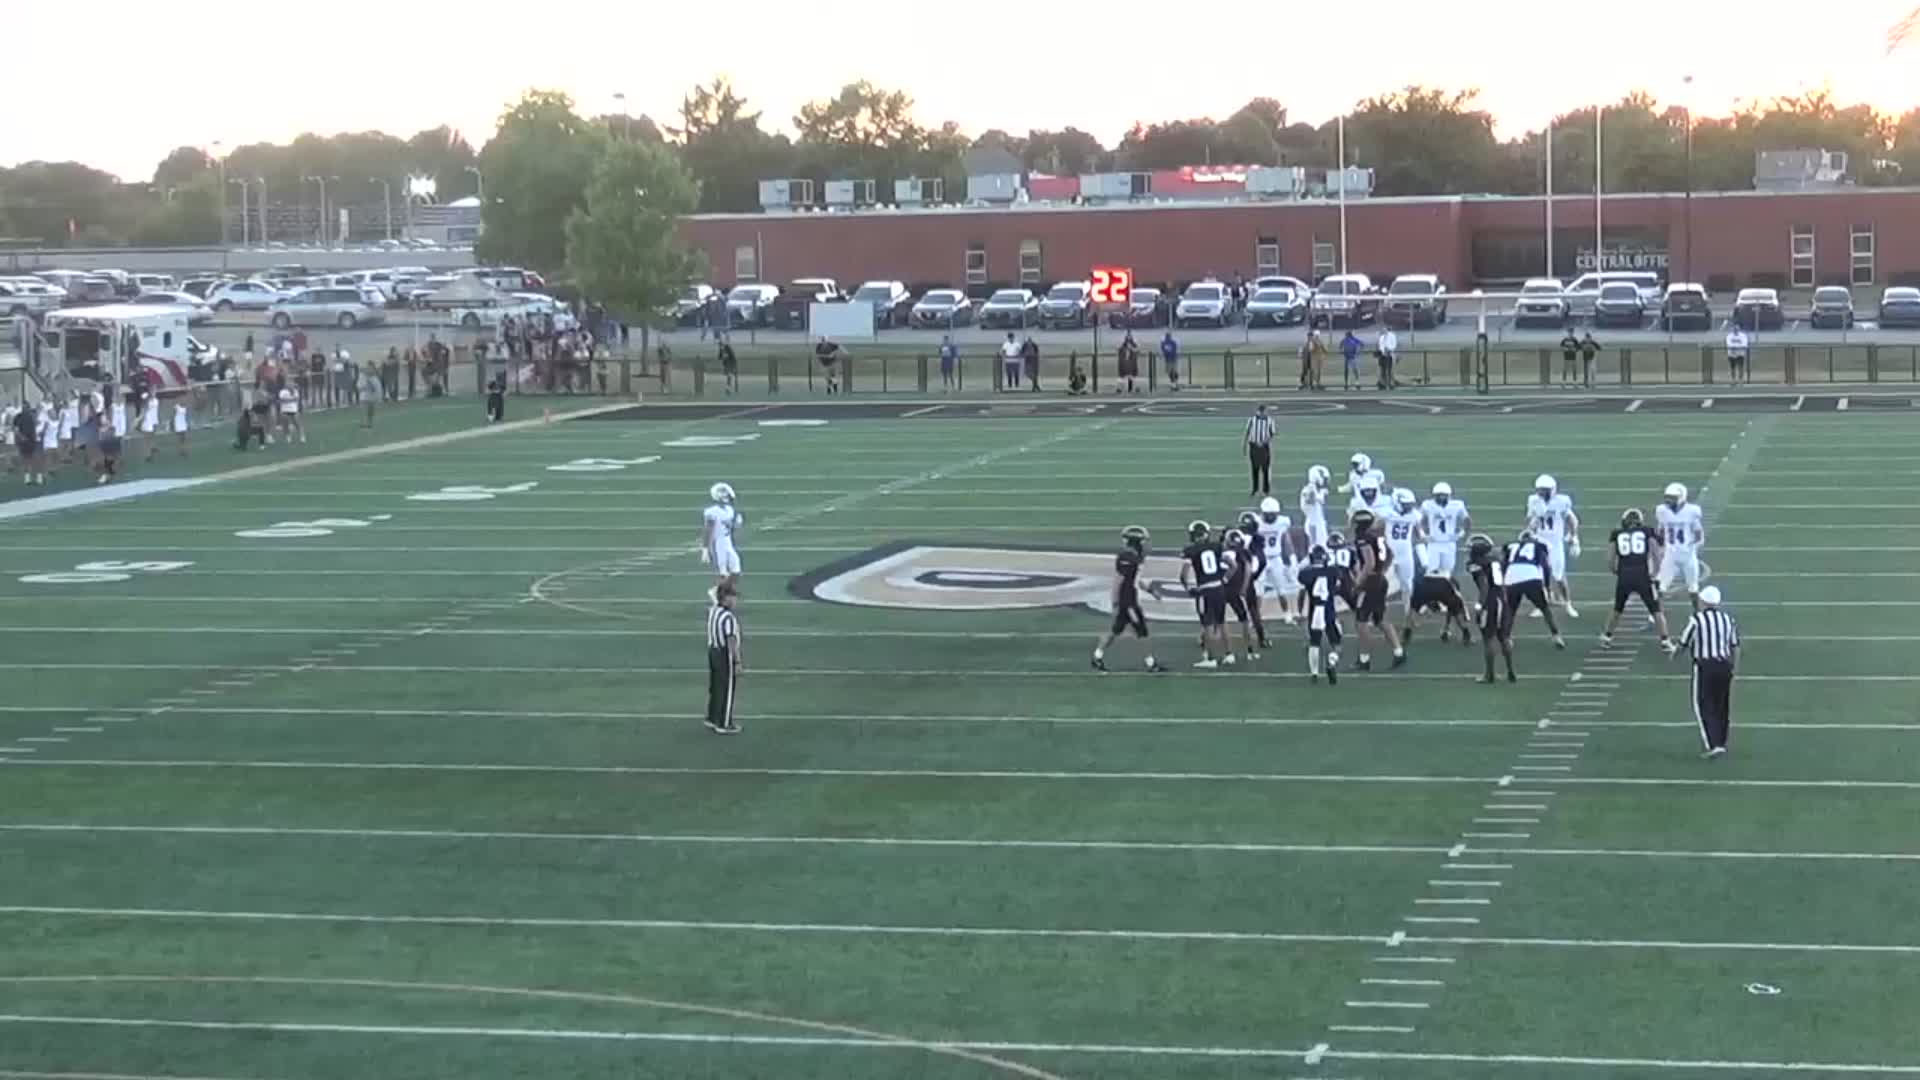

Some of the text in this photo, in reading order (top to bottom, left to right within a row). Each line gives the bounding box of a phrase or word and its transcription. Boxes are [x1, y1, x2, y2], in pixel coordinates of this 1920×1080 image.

[1092, 270, 1128, 302] 22
[1508, 542, 1536, 563] 74
[1617, 531, 1646, 556] 66
[1200, 550, 1218, 574] 0
[1312, 576, 1328, 601] 4
